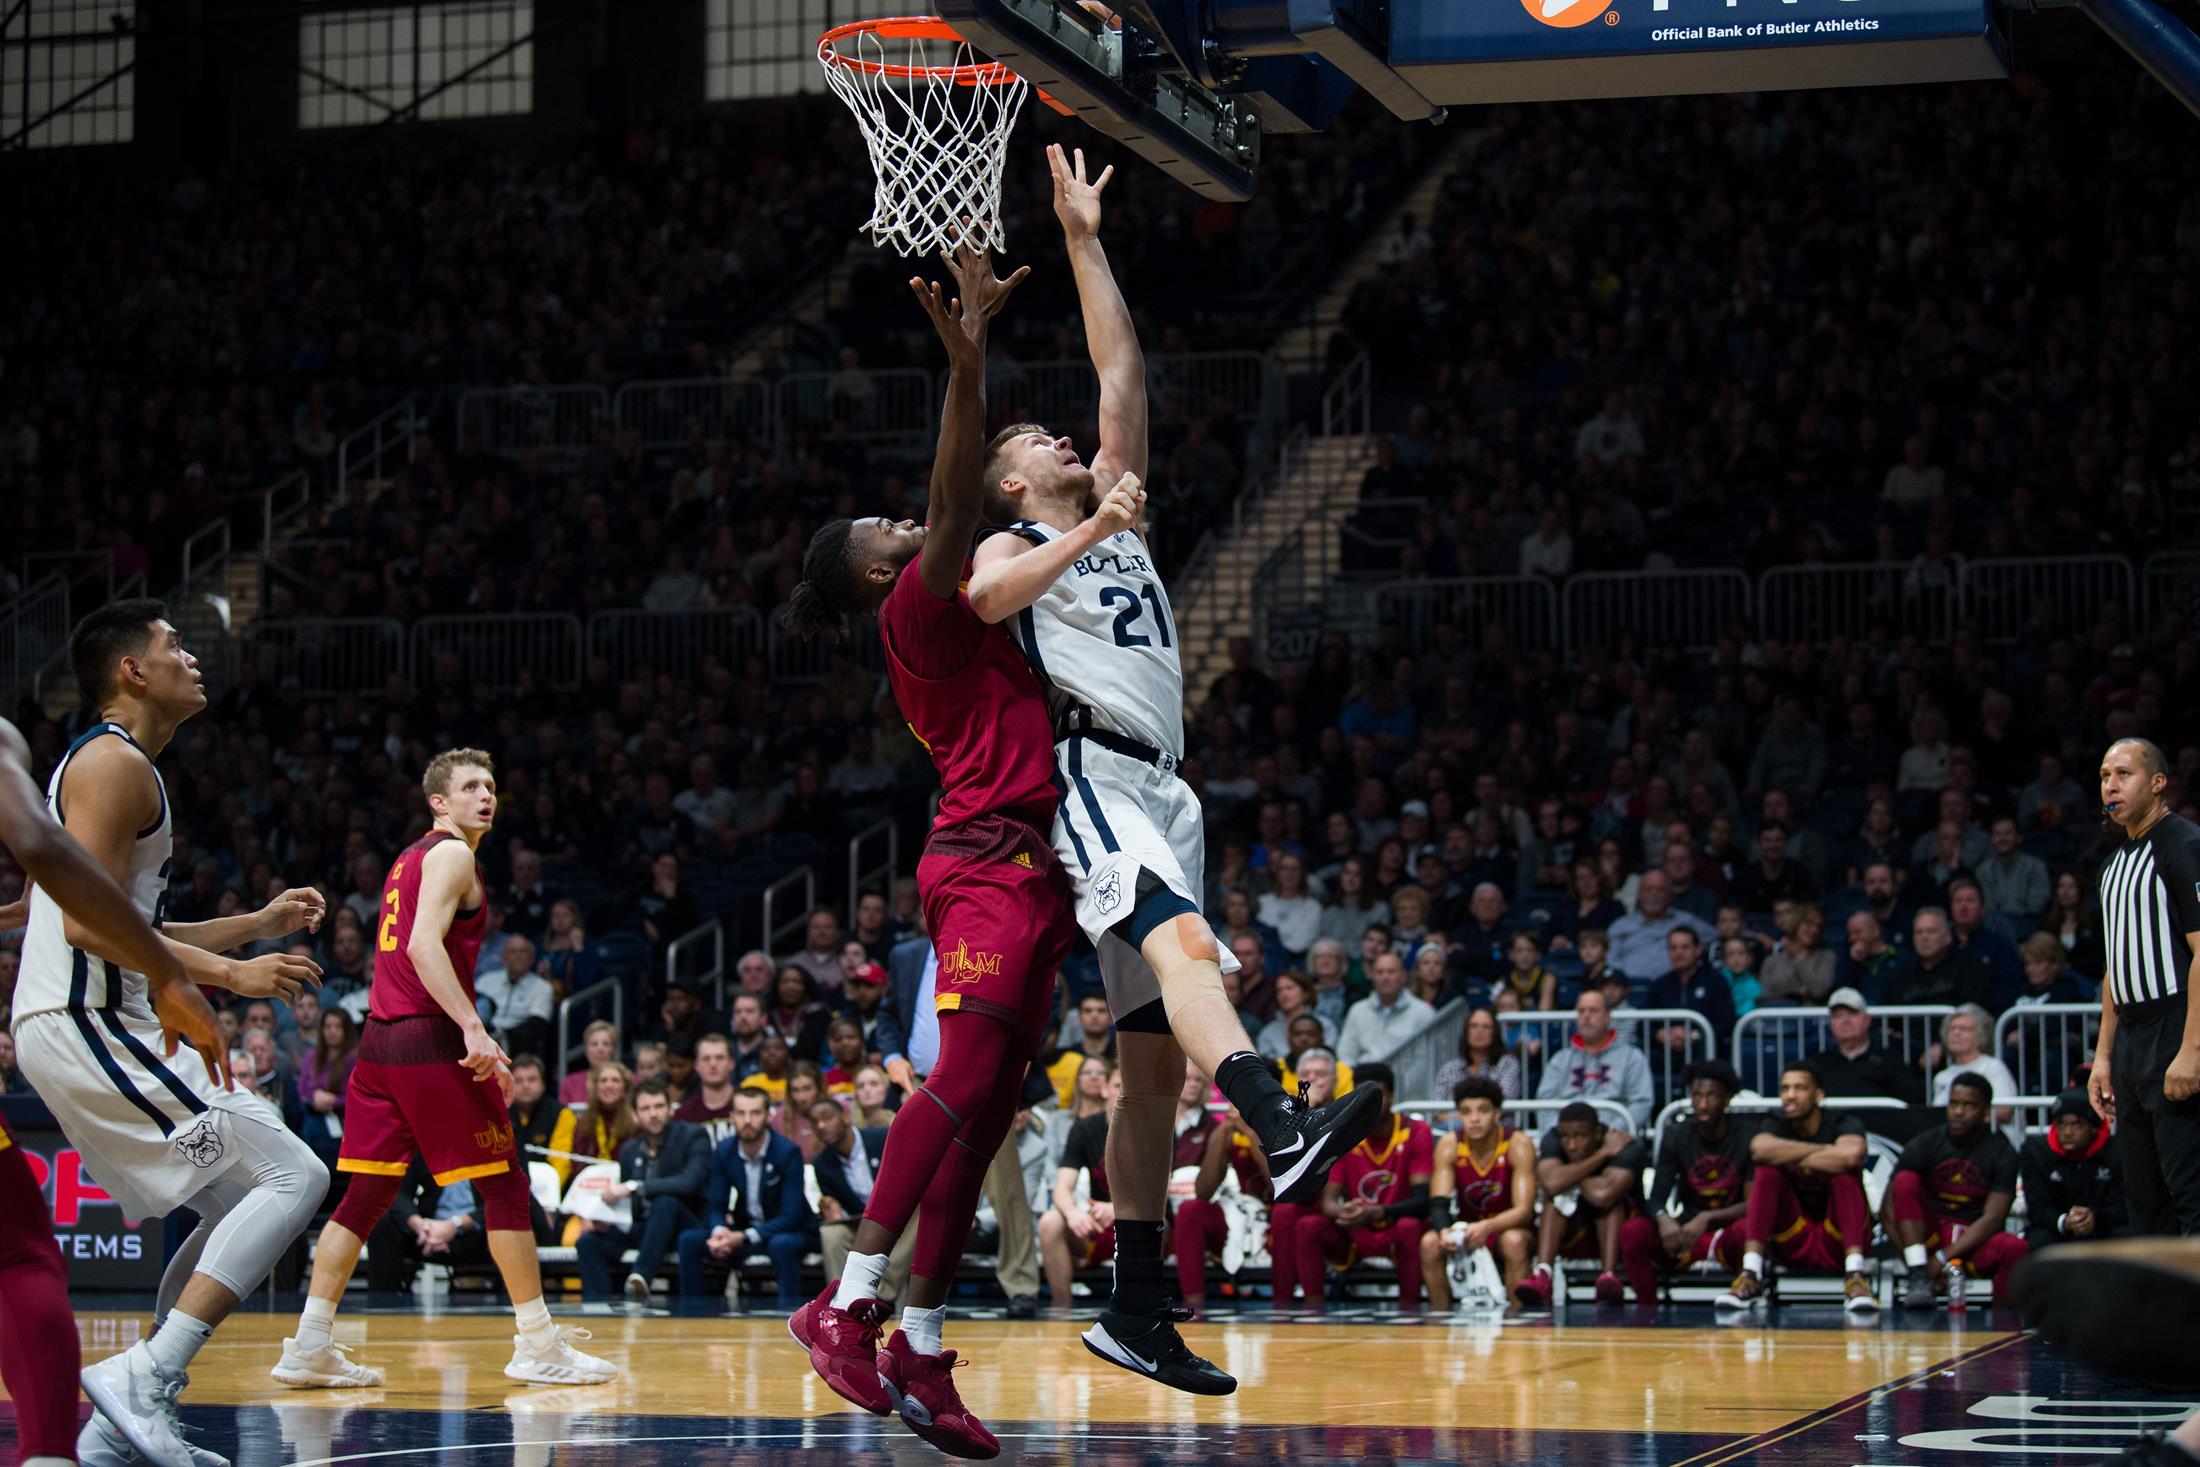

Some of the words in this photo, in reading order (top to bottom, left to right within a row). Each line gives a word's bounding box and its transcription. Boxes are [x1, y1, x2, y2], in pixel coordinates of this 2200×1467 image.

[1651, 28, 1703, 41] Official
[1706, 26, 1743, 39] Bank
[1746, 24, 1763, 36] of
[1766, 22, 1811, 35] Butler
[1814, 19, 1880, 33] Athletics
[1099, 583, 1171, 648] 21
